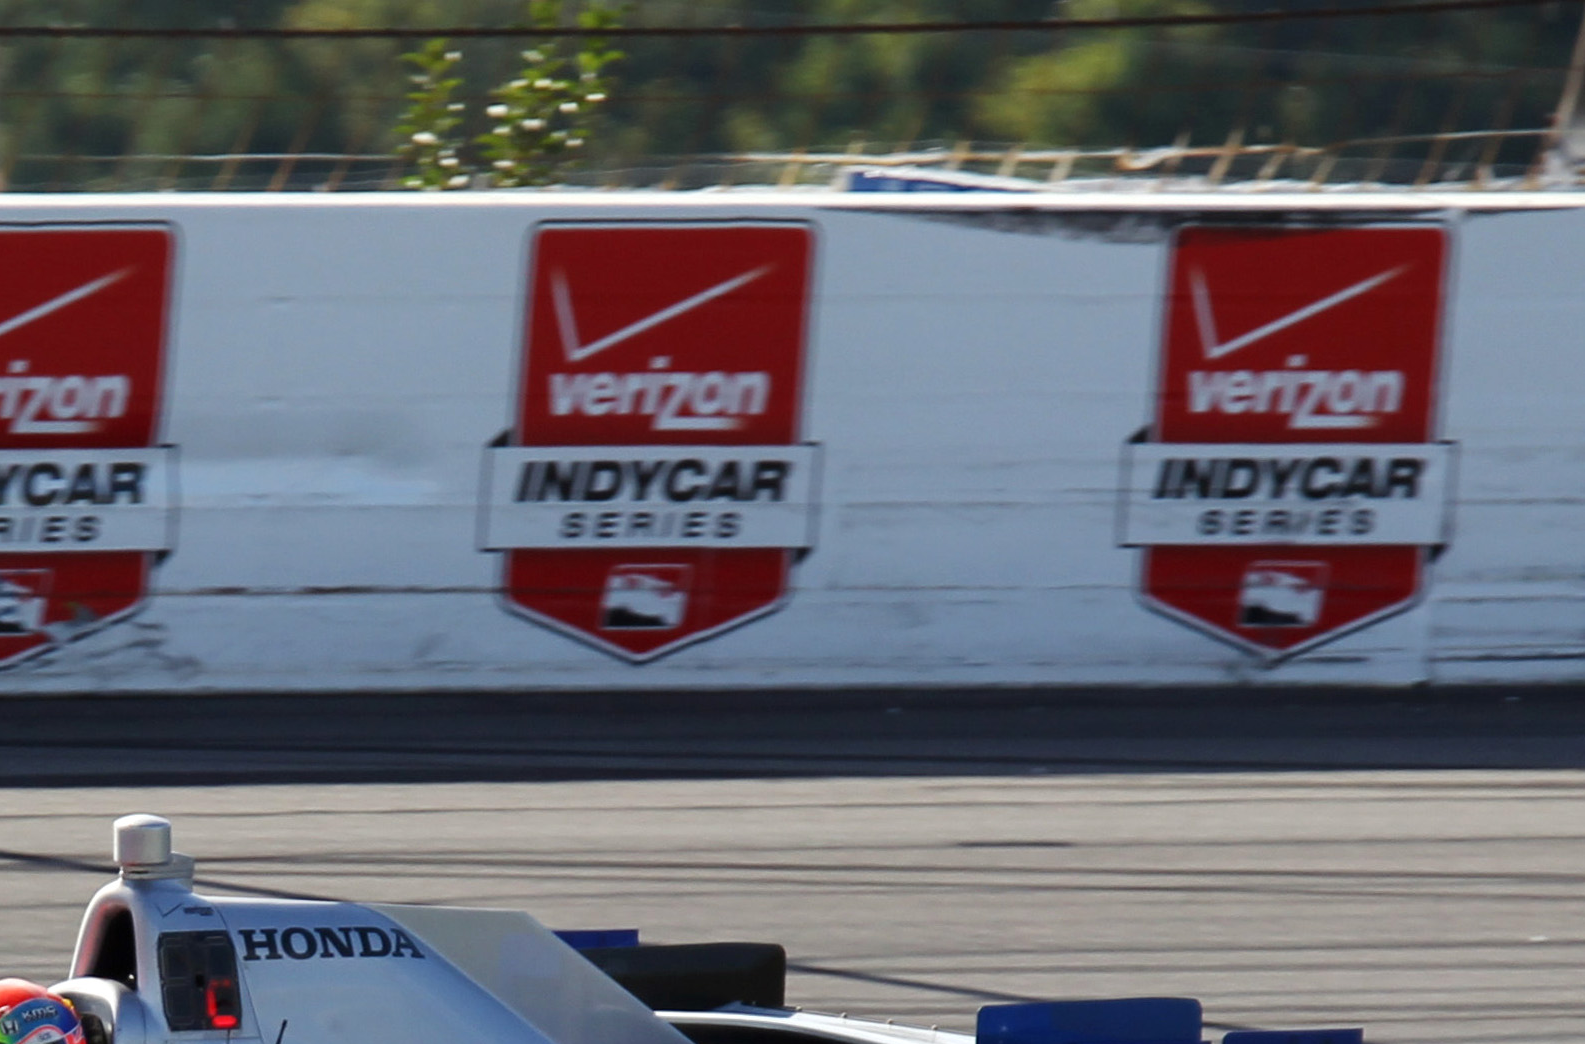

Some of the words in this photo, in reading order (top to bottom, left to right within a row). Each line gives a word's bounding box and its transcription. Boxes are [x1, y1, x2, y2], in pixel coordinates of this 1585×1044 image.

[548, 355, 773, 431] verizon
[1187, 354, 1405, 430] verizon
[516, 459, 793, 502] INDYCAR
[1156, 457, 1426, 500] INDYCAR
[558, 511, 743, 538] SERIES
[1196, 510, 1377, 536] SERIES
[238, 926, 426, 962] HONDA
